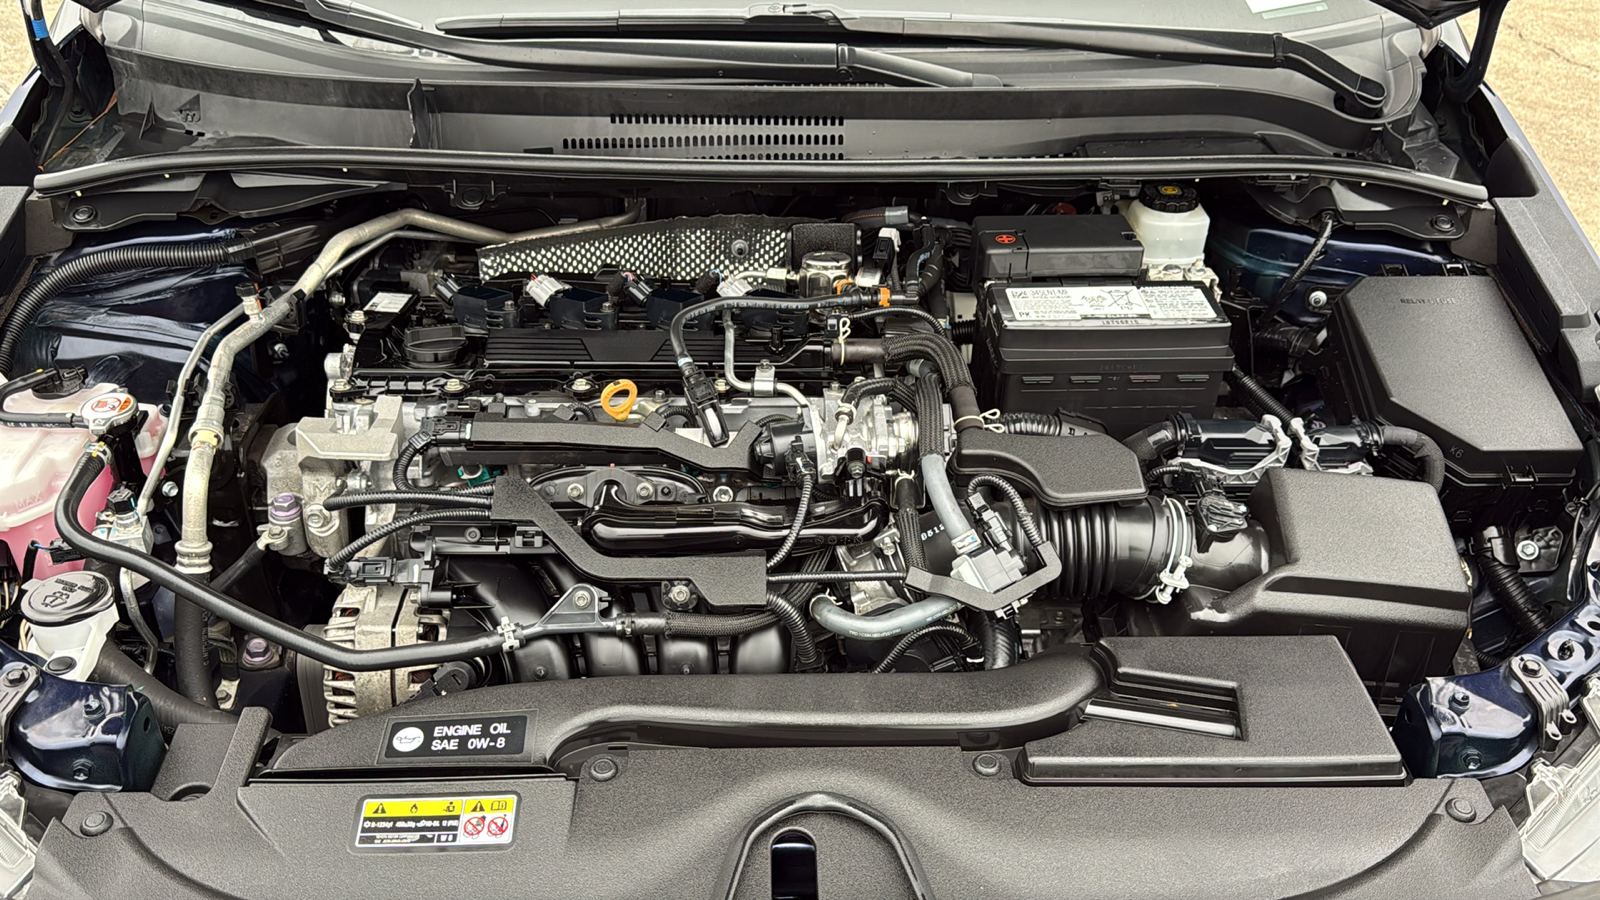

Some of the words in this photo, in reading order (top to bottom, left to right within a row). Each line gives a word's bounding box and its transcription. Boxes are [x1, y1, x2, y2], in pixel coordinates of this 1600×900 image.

[1449, 445, 1464, 459] K6
[13, 490, 43, 510] MAX
[433, 724, 483, 736] ENGINE
[489, 723, 511, 734] OIL
[430, 739, 459, 751] SAE
[467, 737, 505, 750] 0W-8
